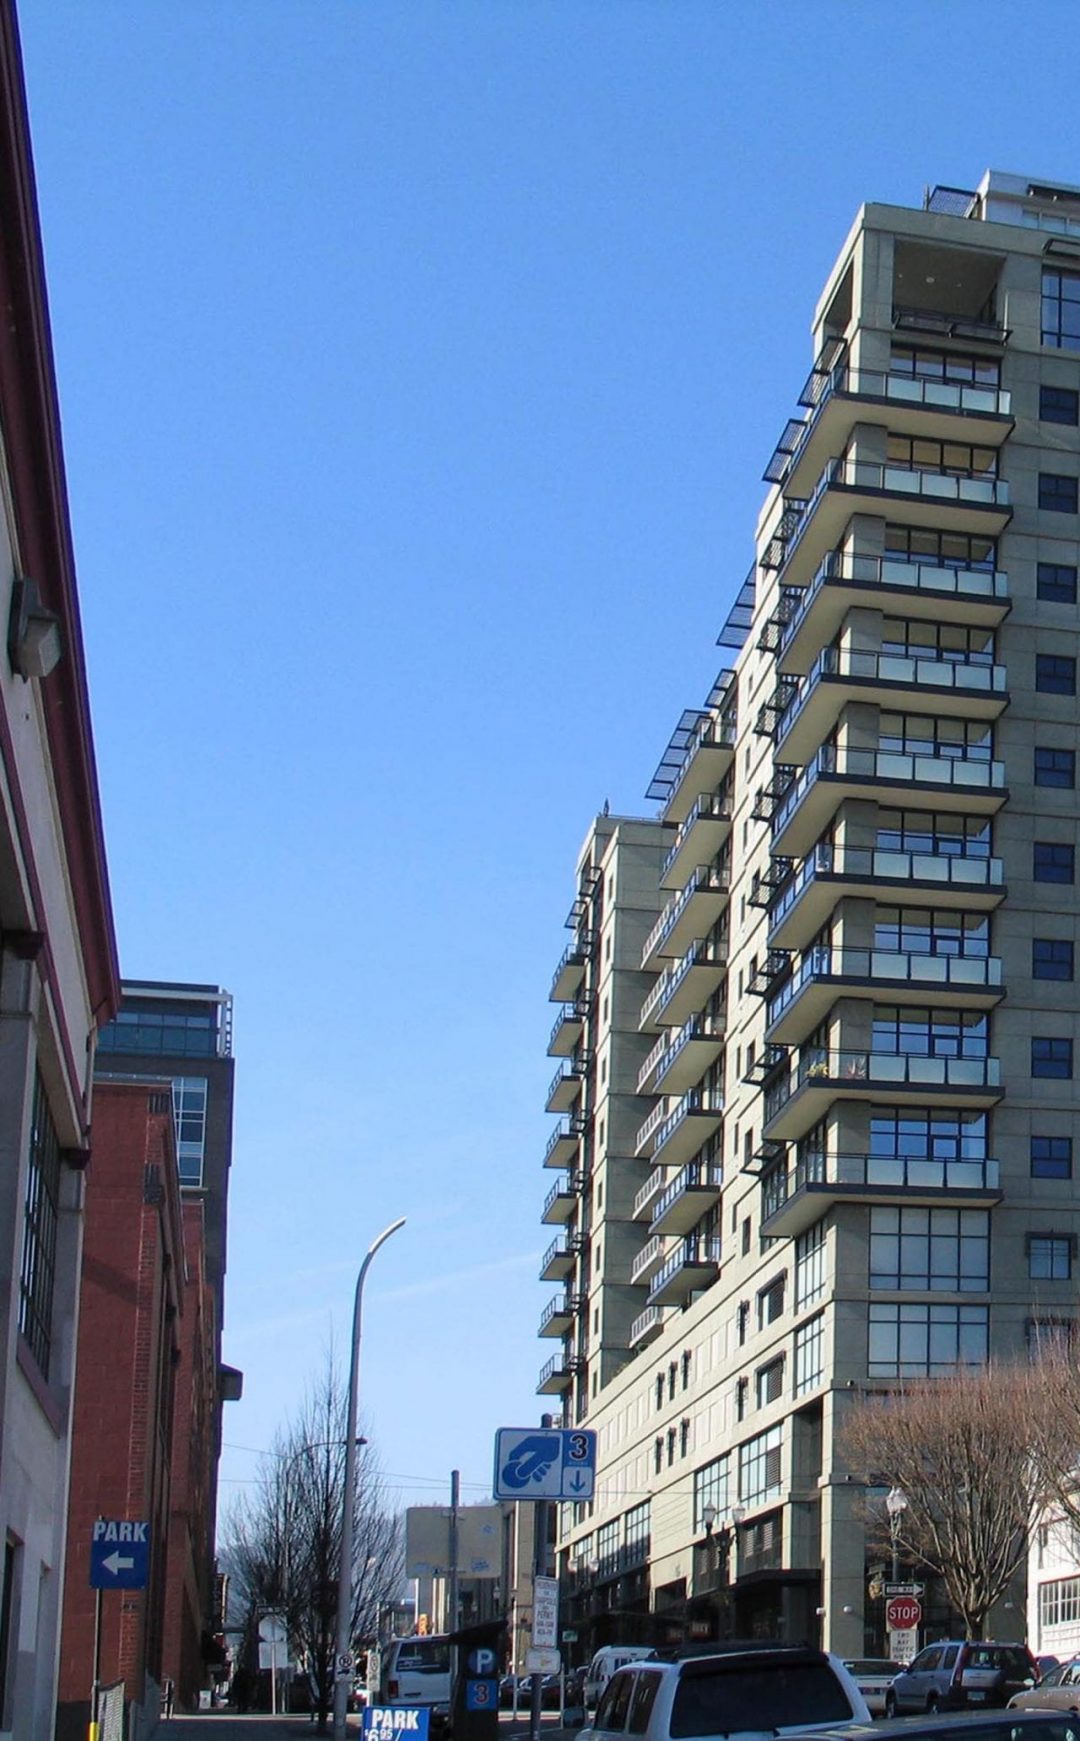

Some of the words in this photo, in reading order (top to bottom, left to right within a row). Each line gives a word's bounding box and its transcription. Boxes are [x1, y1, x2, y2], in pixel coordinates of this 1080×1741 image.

[569, 1433, 589, 1460] 3
[93, 1521, 149, 1542] PARK
[889, 1606, 919, 1620] STOP
[477, 1648, 494, 1674] P
[474, 1682, 490, 1704] 3
[372, 1709, 419, 1729] PARK
